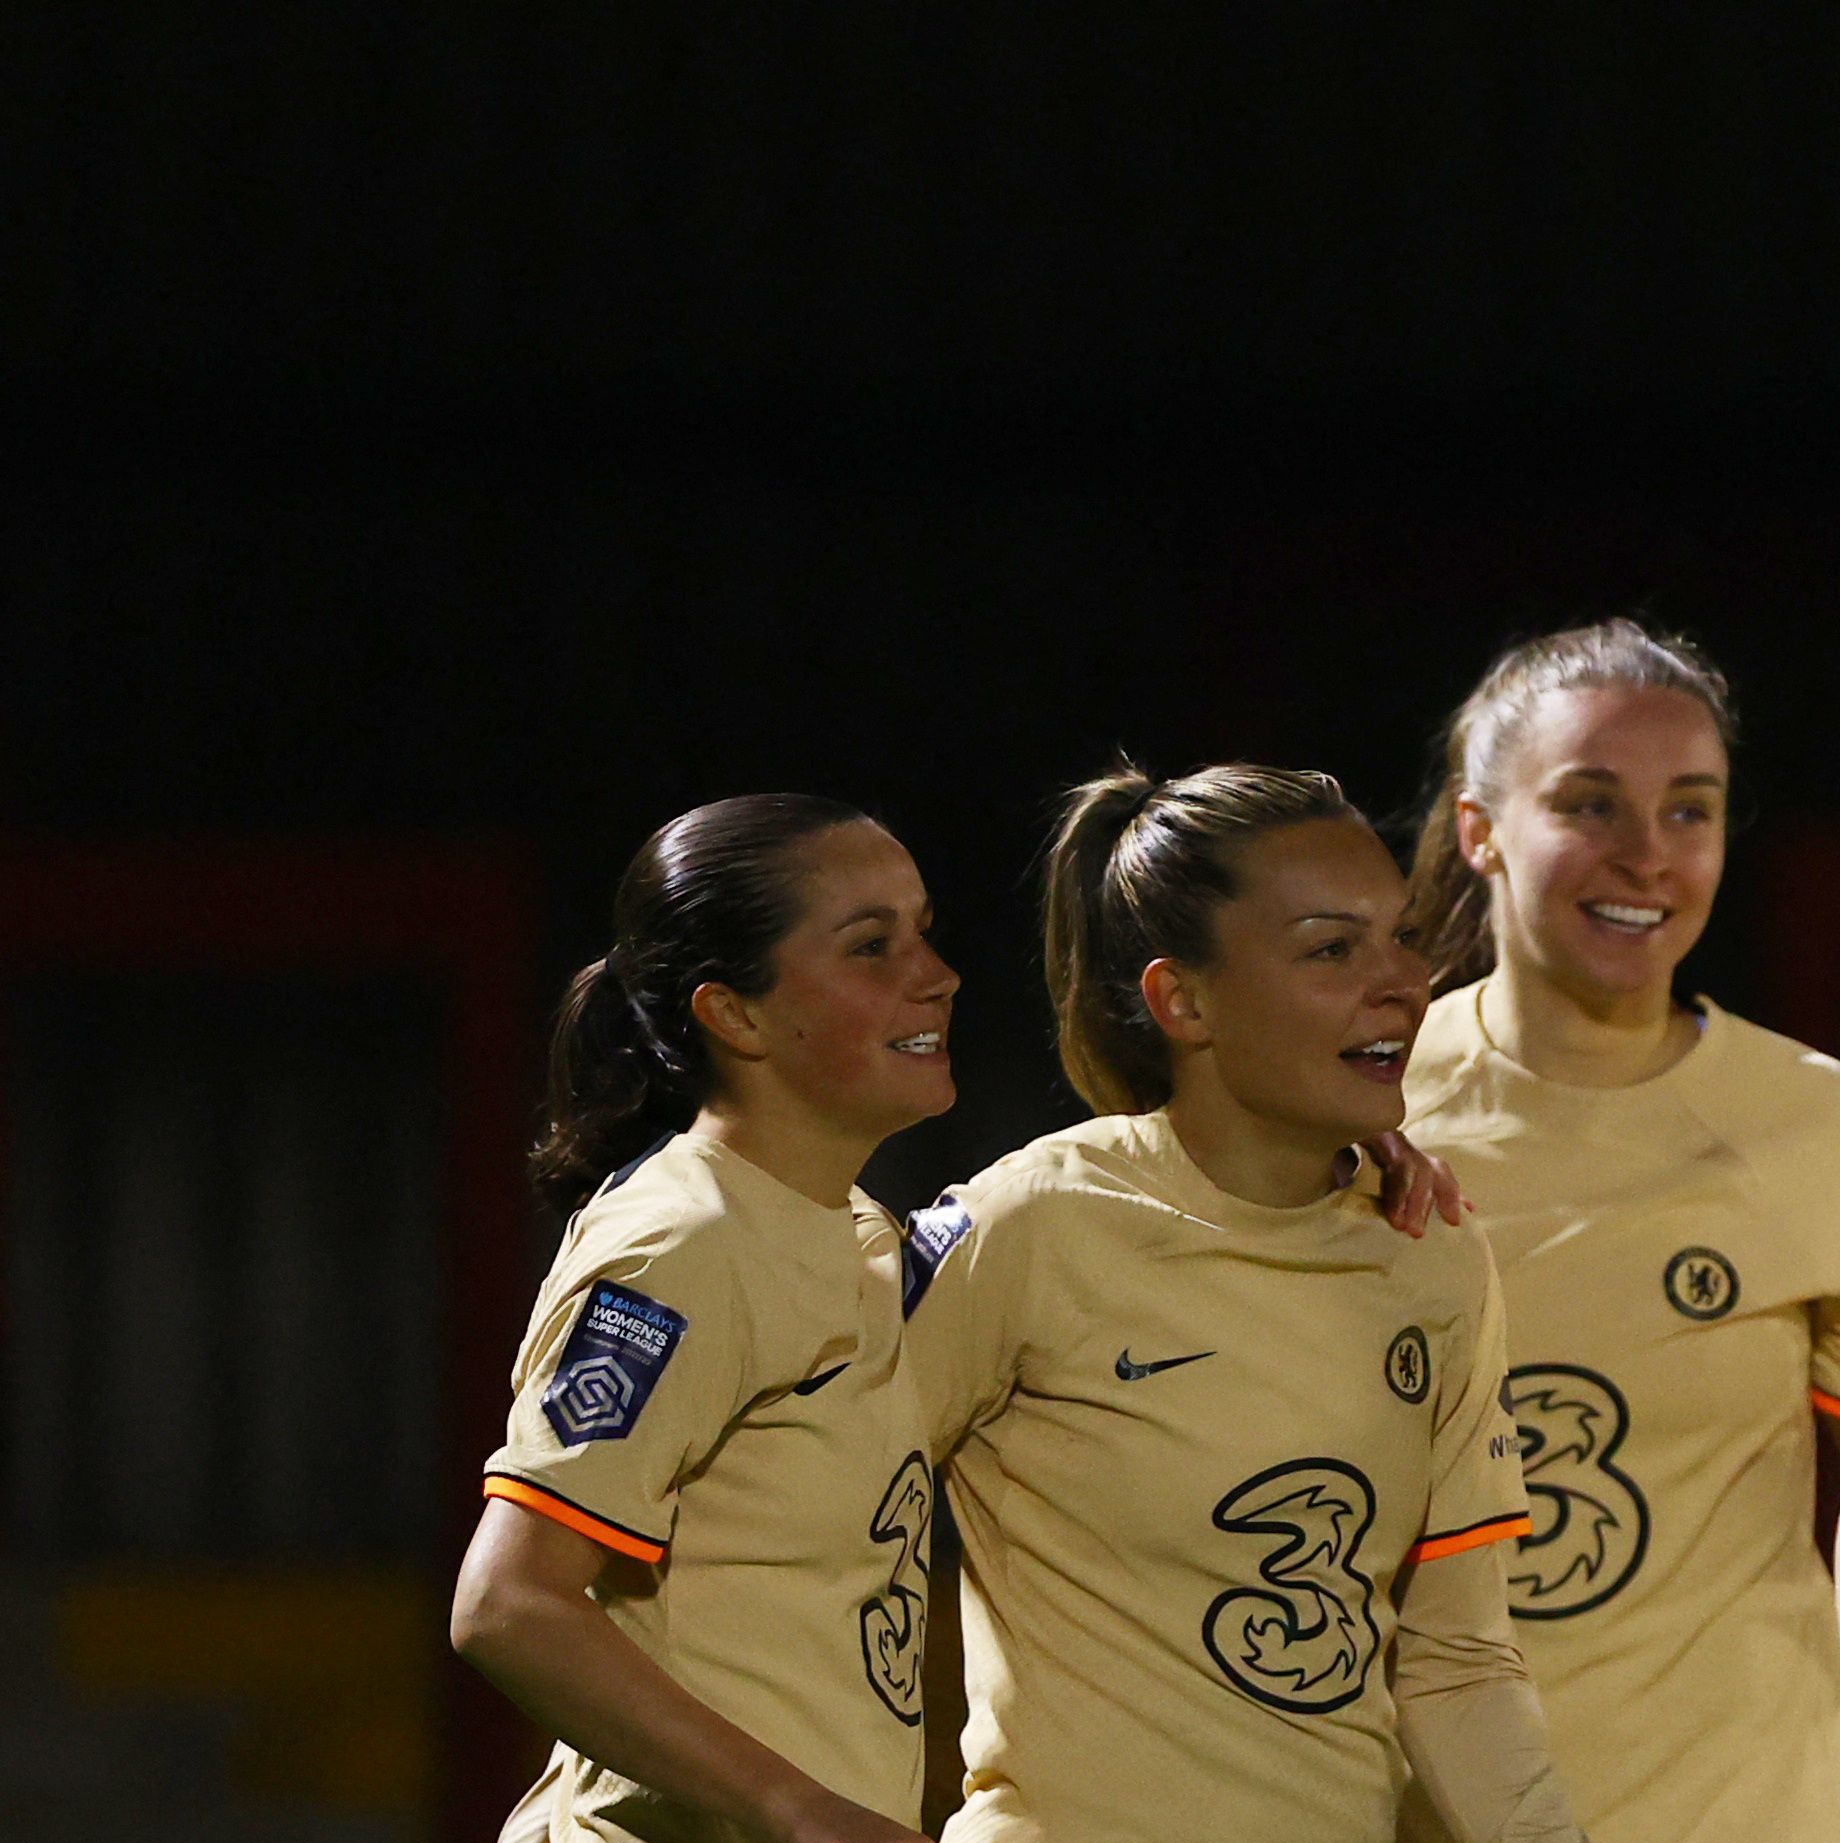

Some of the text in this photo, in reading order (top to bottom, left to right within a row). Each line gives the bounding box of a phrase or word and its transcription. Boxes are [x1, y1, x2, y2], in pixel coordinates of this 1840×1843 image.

[592, 1304, 669, 1347] WOMEN'S
[612, 1297, 677, 1334] BARCLAYS
[586, 1318, 620, 1338] SUPER
[619, 1328, 664, 1358] LEAGUE
[1203, 1457, 1381, 1714] 3
